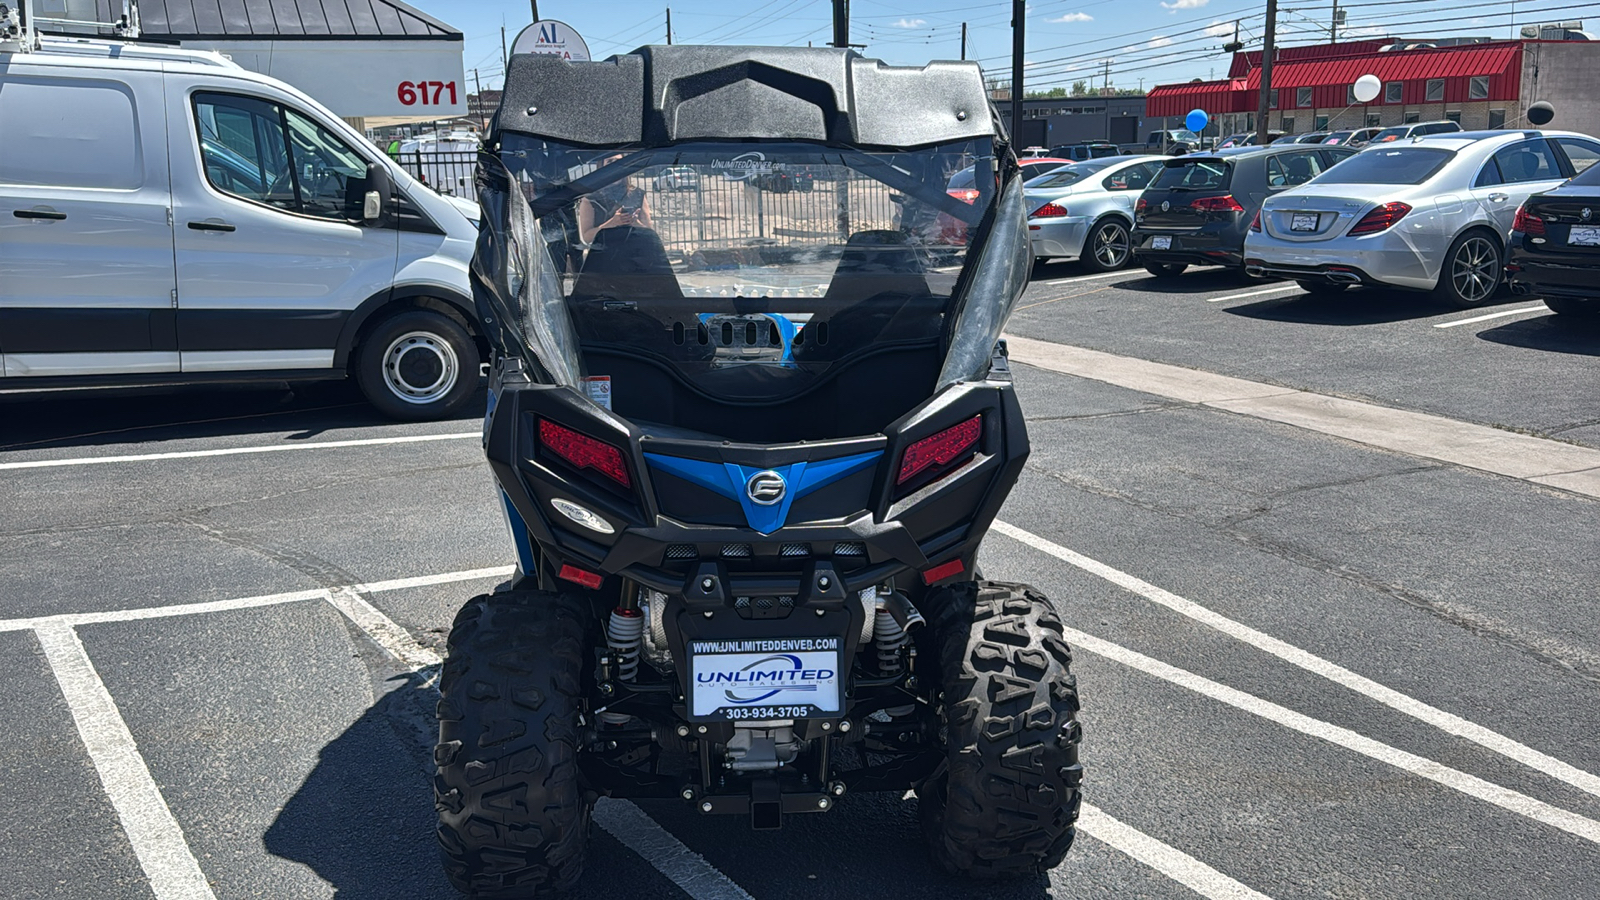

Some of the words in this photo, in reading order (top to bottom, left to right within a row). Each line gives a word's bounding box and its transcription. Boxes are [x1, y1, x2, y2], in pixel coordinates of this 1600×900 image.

[397, 81, 458, 105] 6171
[697, 670, 834, 683] UNLIMITED
[726, 706, 808, 719] 303-934-3705
